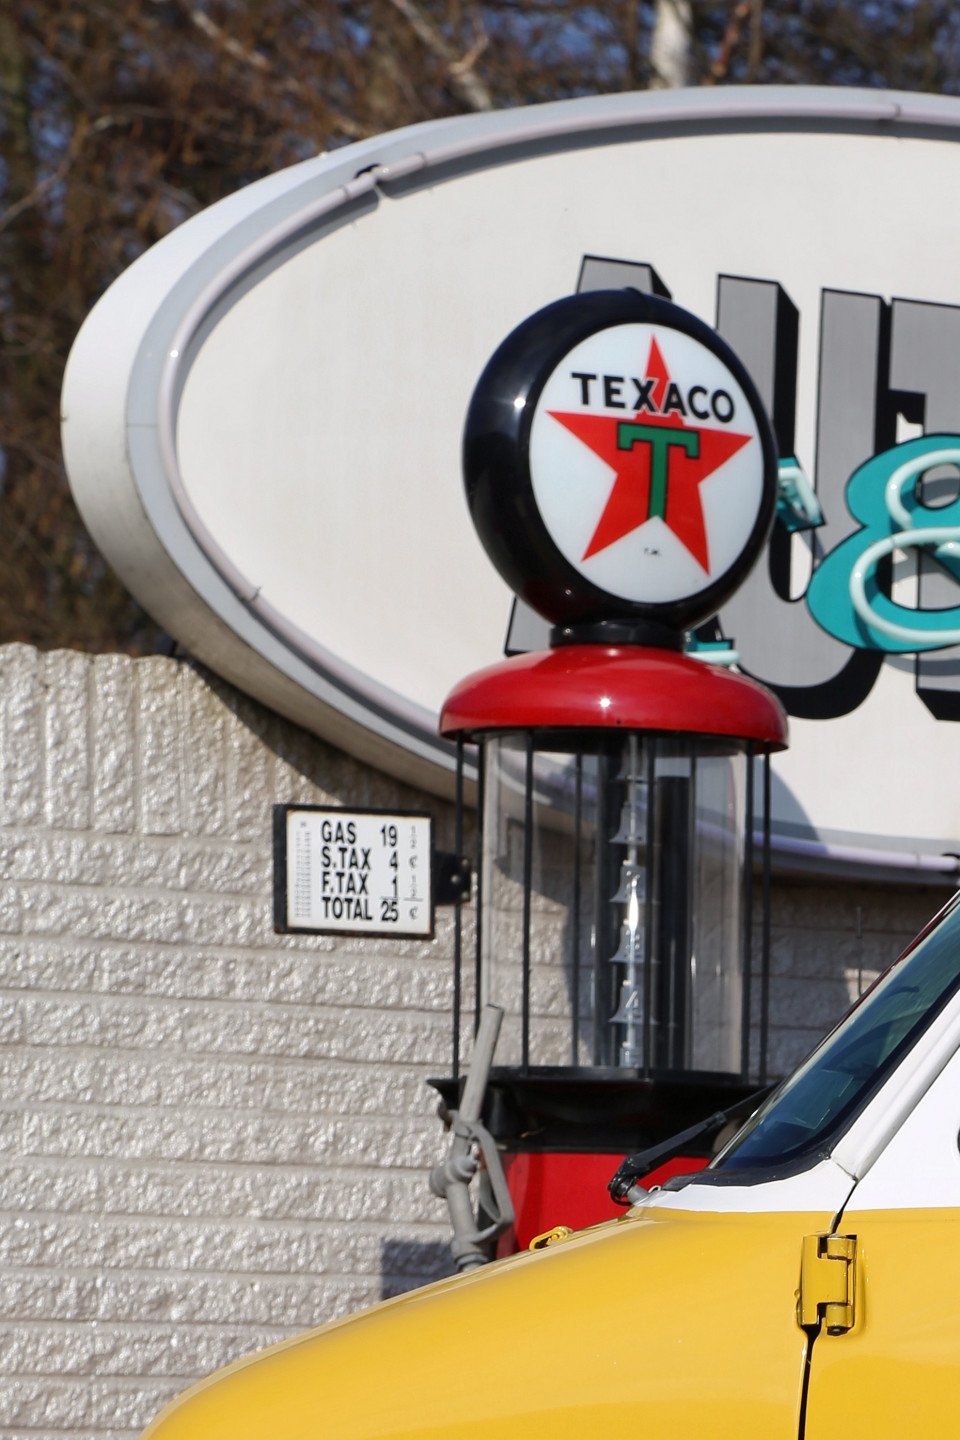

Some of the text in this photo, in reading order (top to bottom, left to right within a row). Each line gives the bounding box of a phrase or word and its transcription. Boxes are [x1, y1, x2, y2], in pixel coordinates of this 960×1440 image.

[571, 372, 735, 424] TEXACO
[321, 821, 356, 844] GAS
[380, 825, 398, 848] 19
[321, 846, 371, 870] S.TAX
[389, 850, 398, 871] 4
[322, 872, 368, 895] F.TAX
[391, 875, 398, 898] 1
[321, 897, 373, 921] TOTAL
[380, 900, 398, 922] 25
